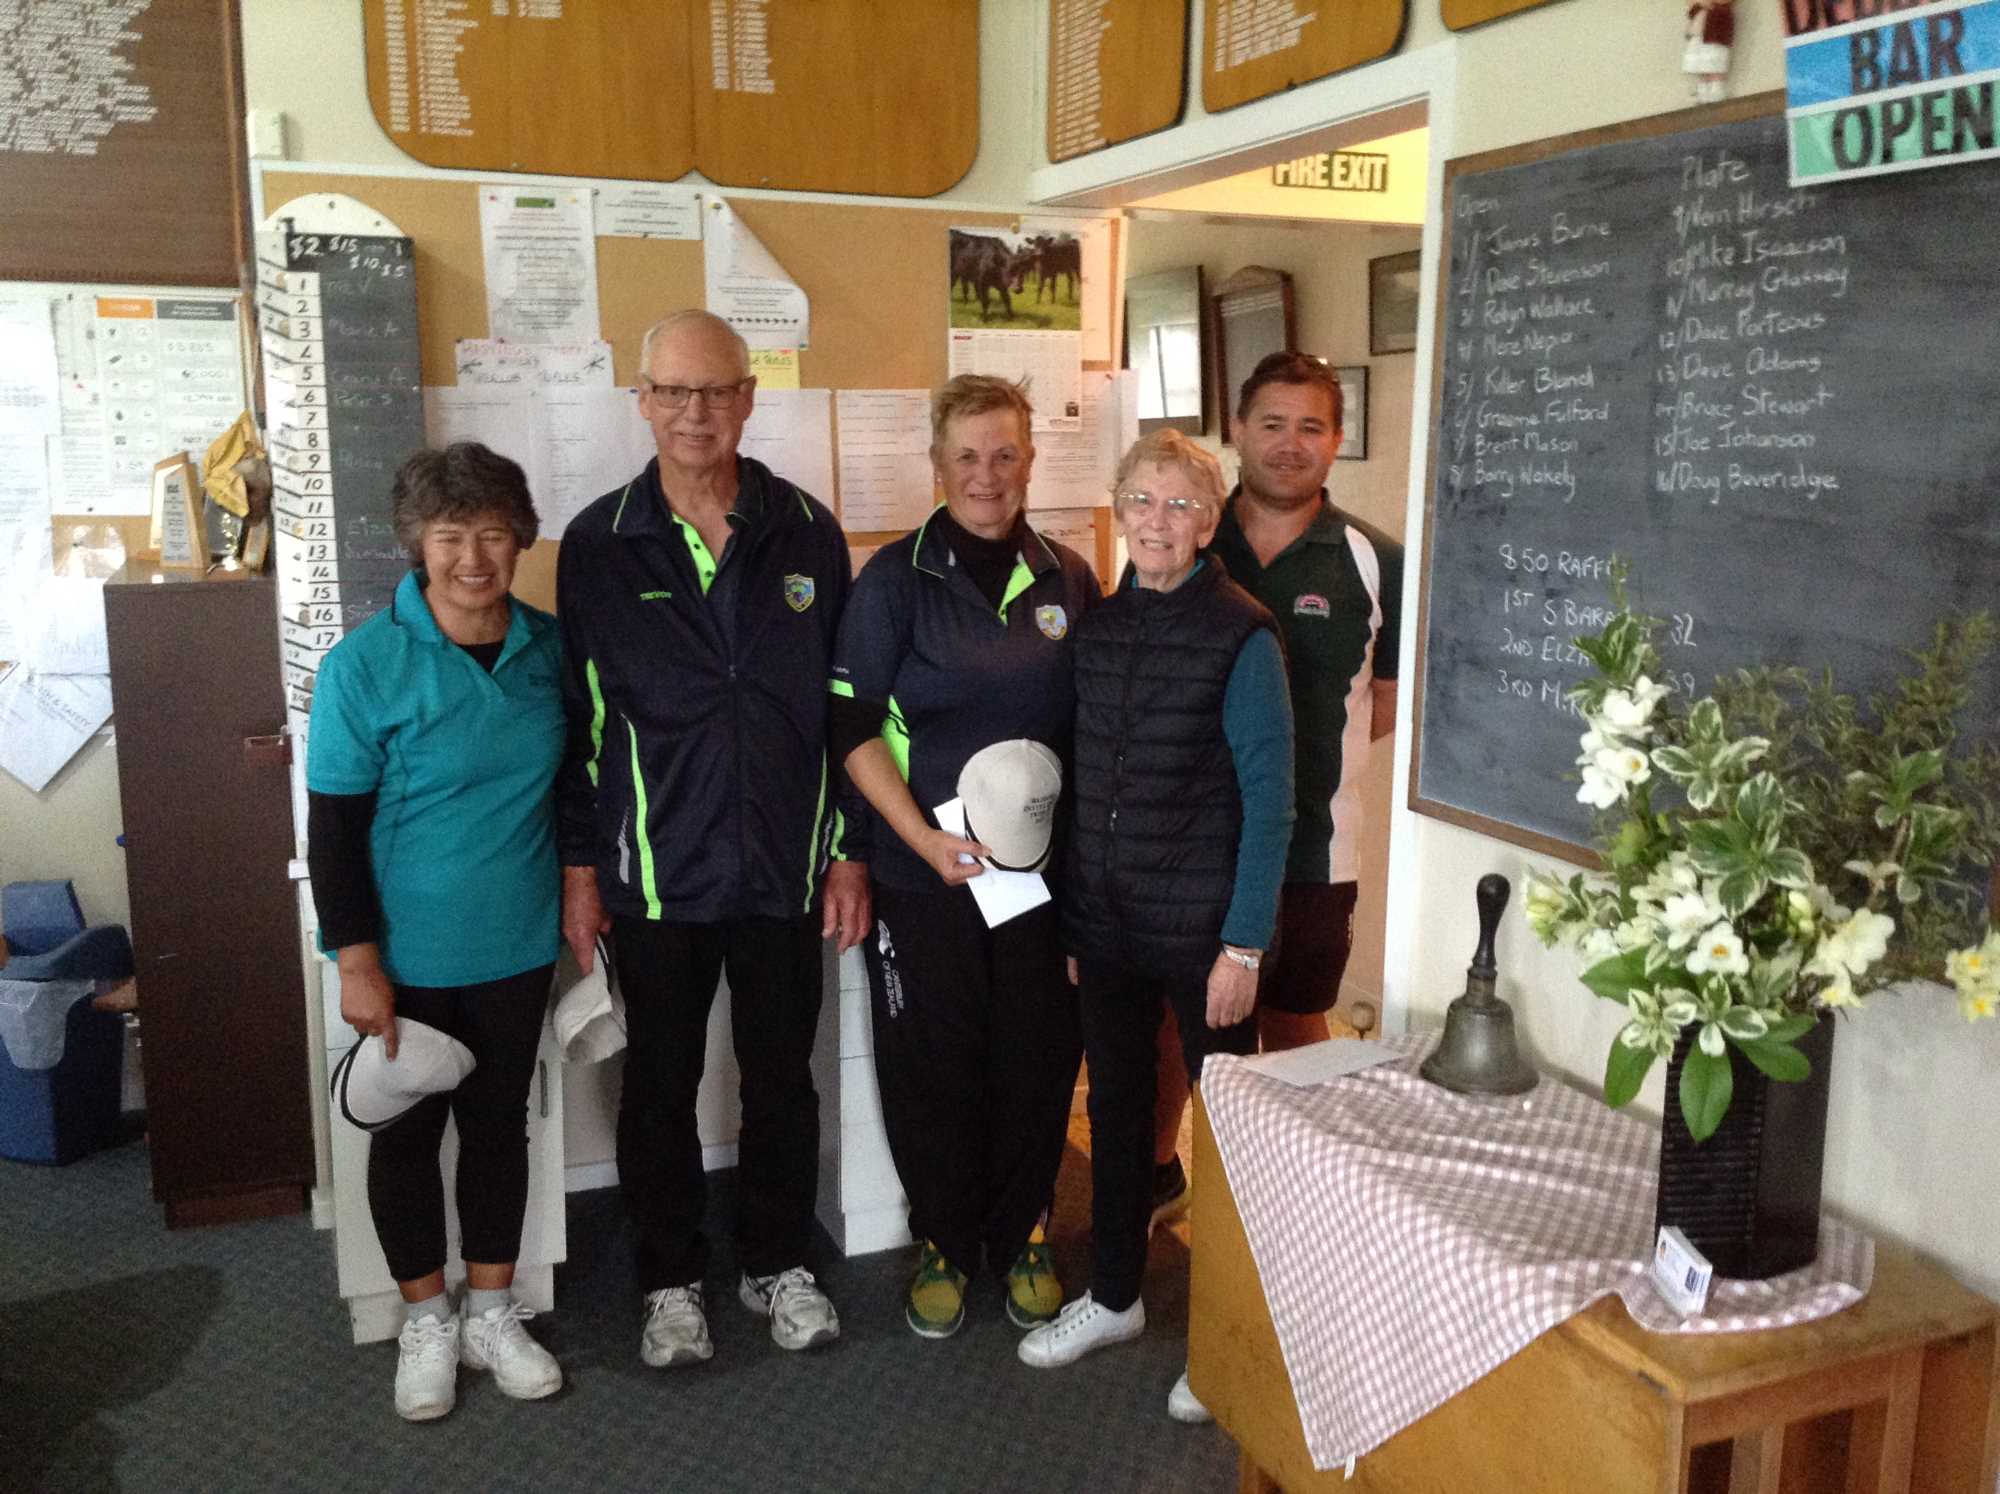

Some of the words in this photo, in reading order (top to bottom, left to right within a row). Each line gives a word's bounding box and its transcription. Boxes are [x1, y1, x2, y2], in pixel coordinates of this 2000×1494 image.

[1851, 10, 1967, 95] BAR
[1832, 81, 1994, 171] OPEN
[1331, 154, 1387, 190] EXIT
[300, 278, 306, 291] 1
[296, 299, 309, 313] 2
[298, 321, 311, 338] 3
[302, 366, 313, 381] 5
[304, 389, 314, 402] 6
[306, 412, 317, 425] 7
[308, 433, 318, 448] 8
[309, 454, 321, 468] 9
[304, 478, 324, 491] 10
[308, 501, 322, 514] 11
[309, 523, 327, 537] 12
[309, 544, 327, 559] 13
[313, 586, 331, 599] 15
[315, 608, 333, 621] 16
[316, 631, 335, 645] 17
[1498, 669, 1533, 697] 3RD
